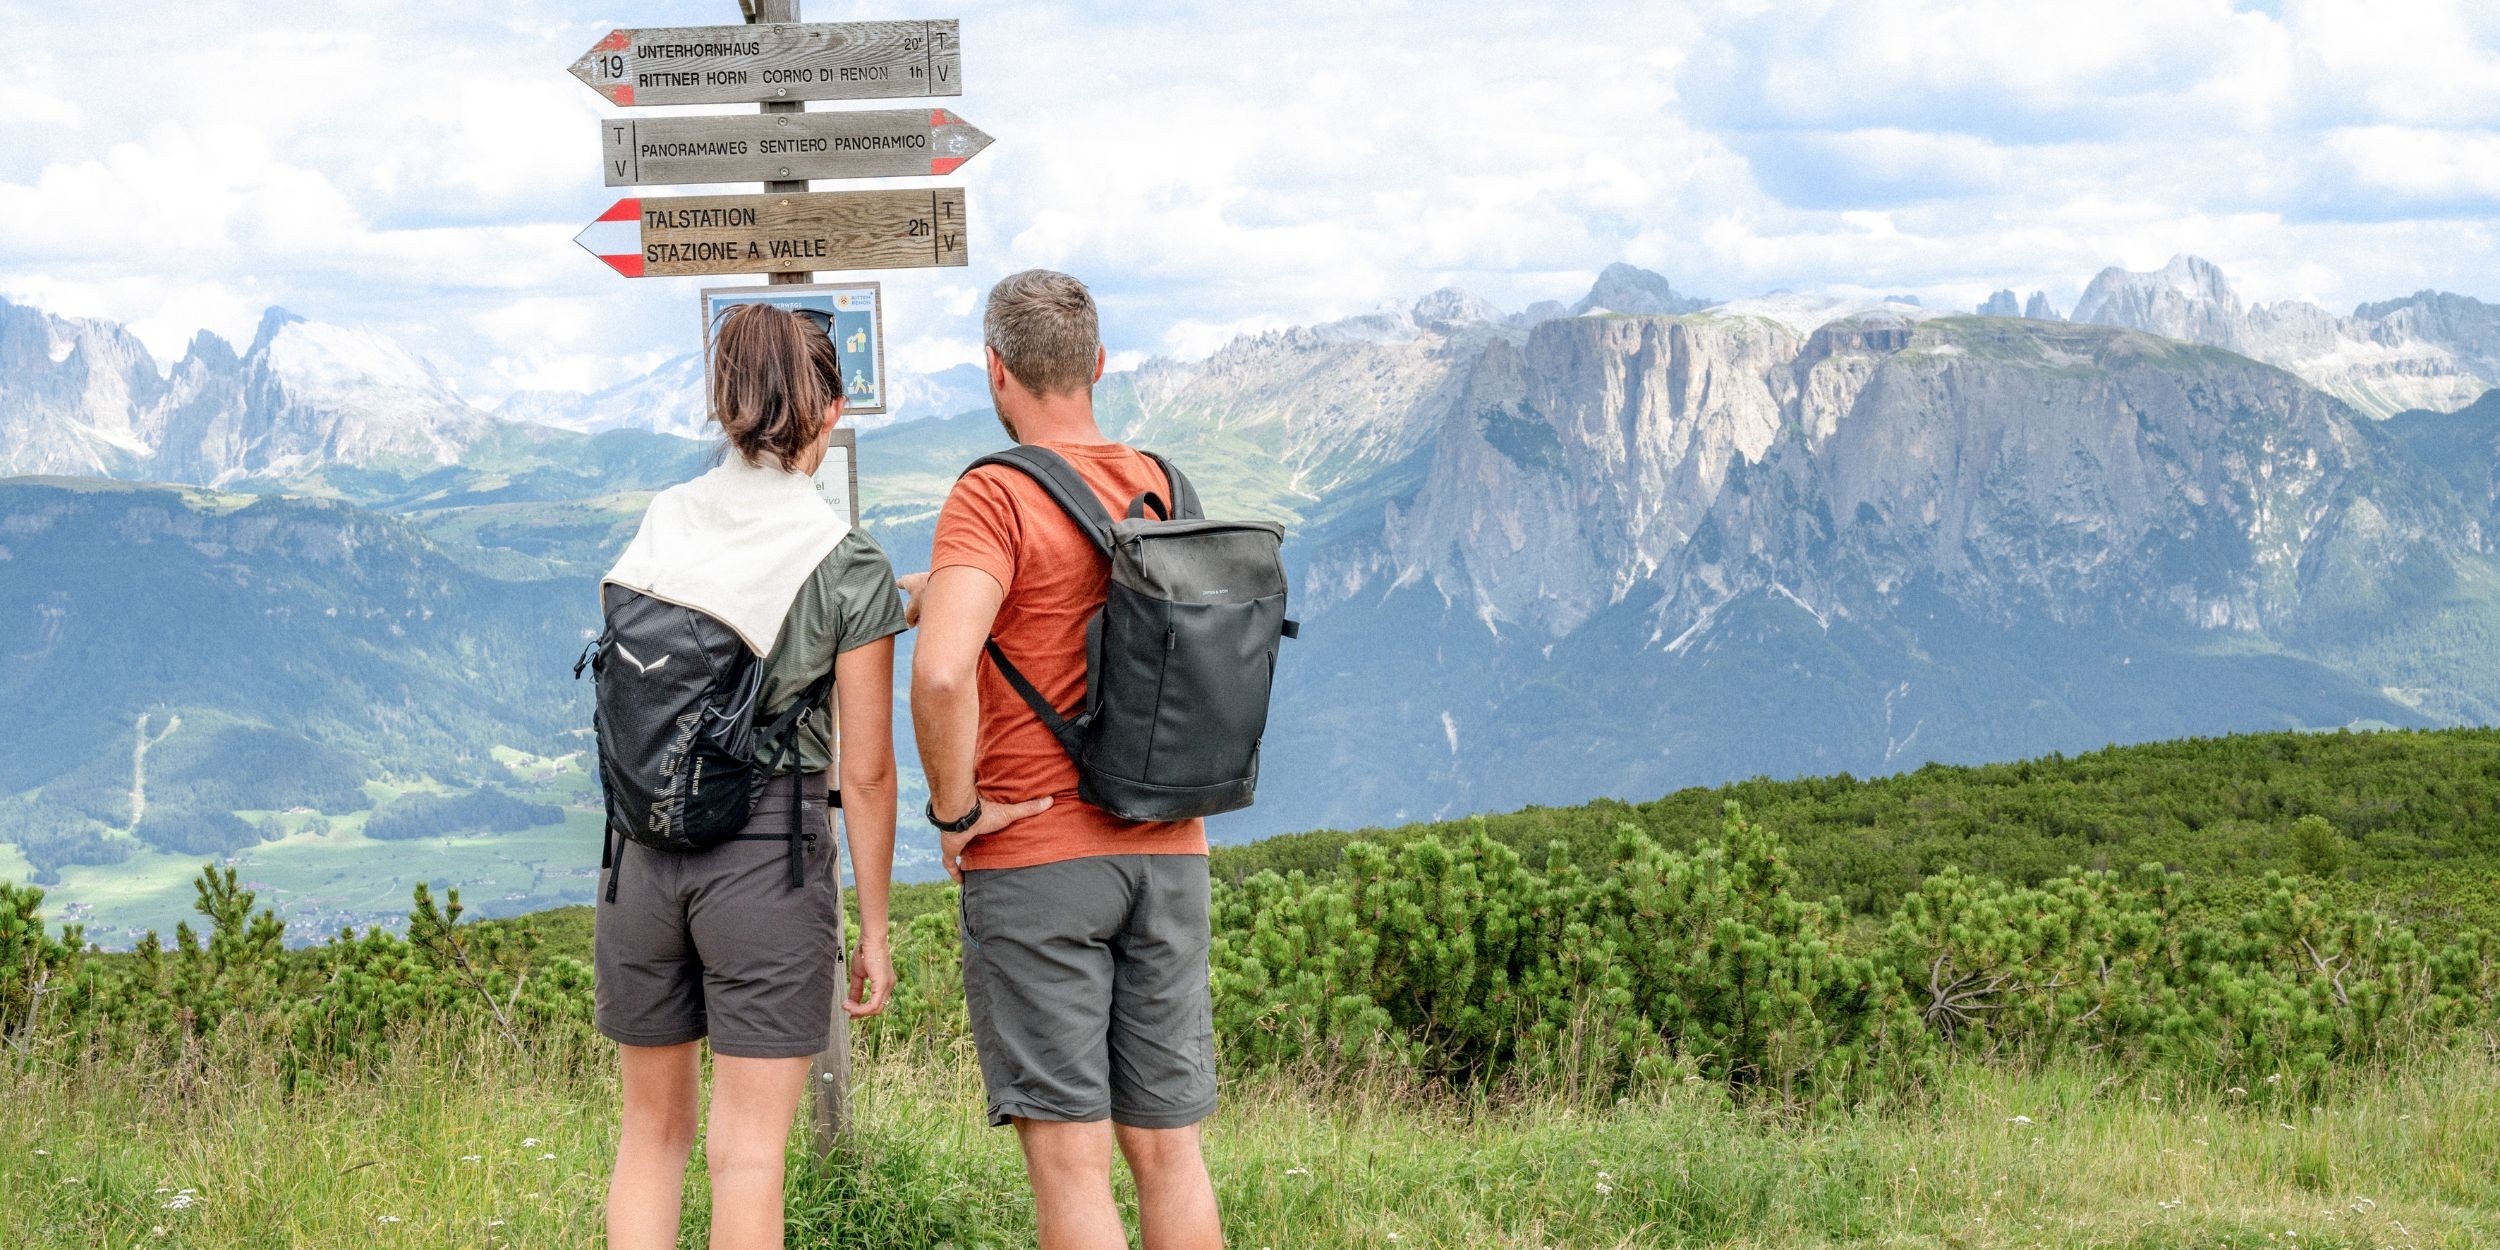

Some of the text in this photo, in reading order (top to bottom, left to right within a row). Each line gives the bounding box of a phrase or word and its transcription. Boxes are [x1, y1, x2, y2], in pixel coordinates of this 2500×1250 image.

[638, 41, 760, 59] UNTERHORNHAUS
[936, 32, 947, 50] T
[599, 55, 624, 79] 19
[909, 66, 923, 79] 1h
[937, 65, 948, 82] V
[639, 66, 889, 87] RITTNER HORN CORNO DI RENON
[613, 127, 625, 145] T
[641, 134, 926, 158] PANORAMAWEG SENTIERO PANORAMICO
[615, 160, 627, 177] V
[645, 208, 756, 229] TALSTATION
[942, 201, 954, 219] T
[909, 218, 929, 236] 2h
[647, 239, 827, 262] STAZIONE A VALLE
[944, 234, 955, 252] V
[649, 712, 701, 837] SALEWA
